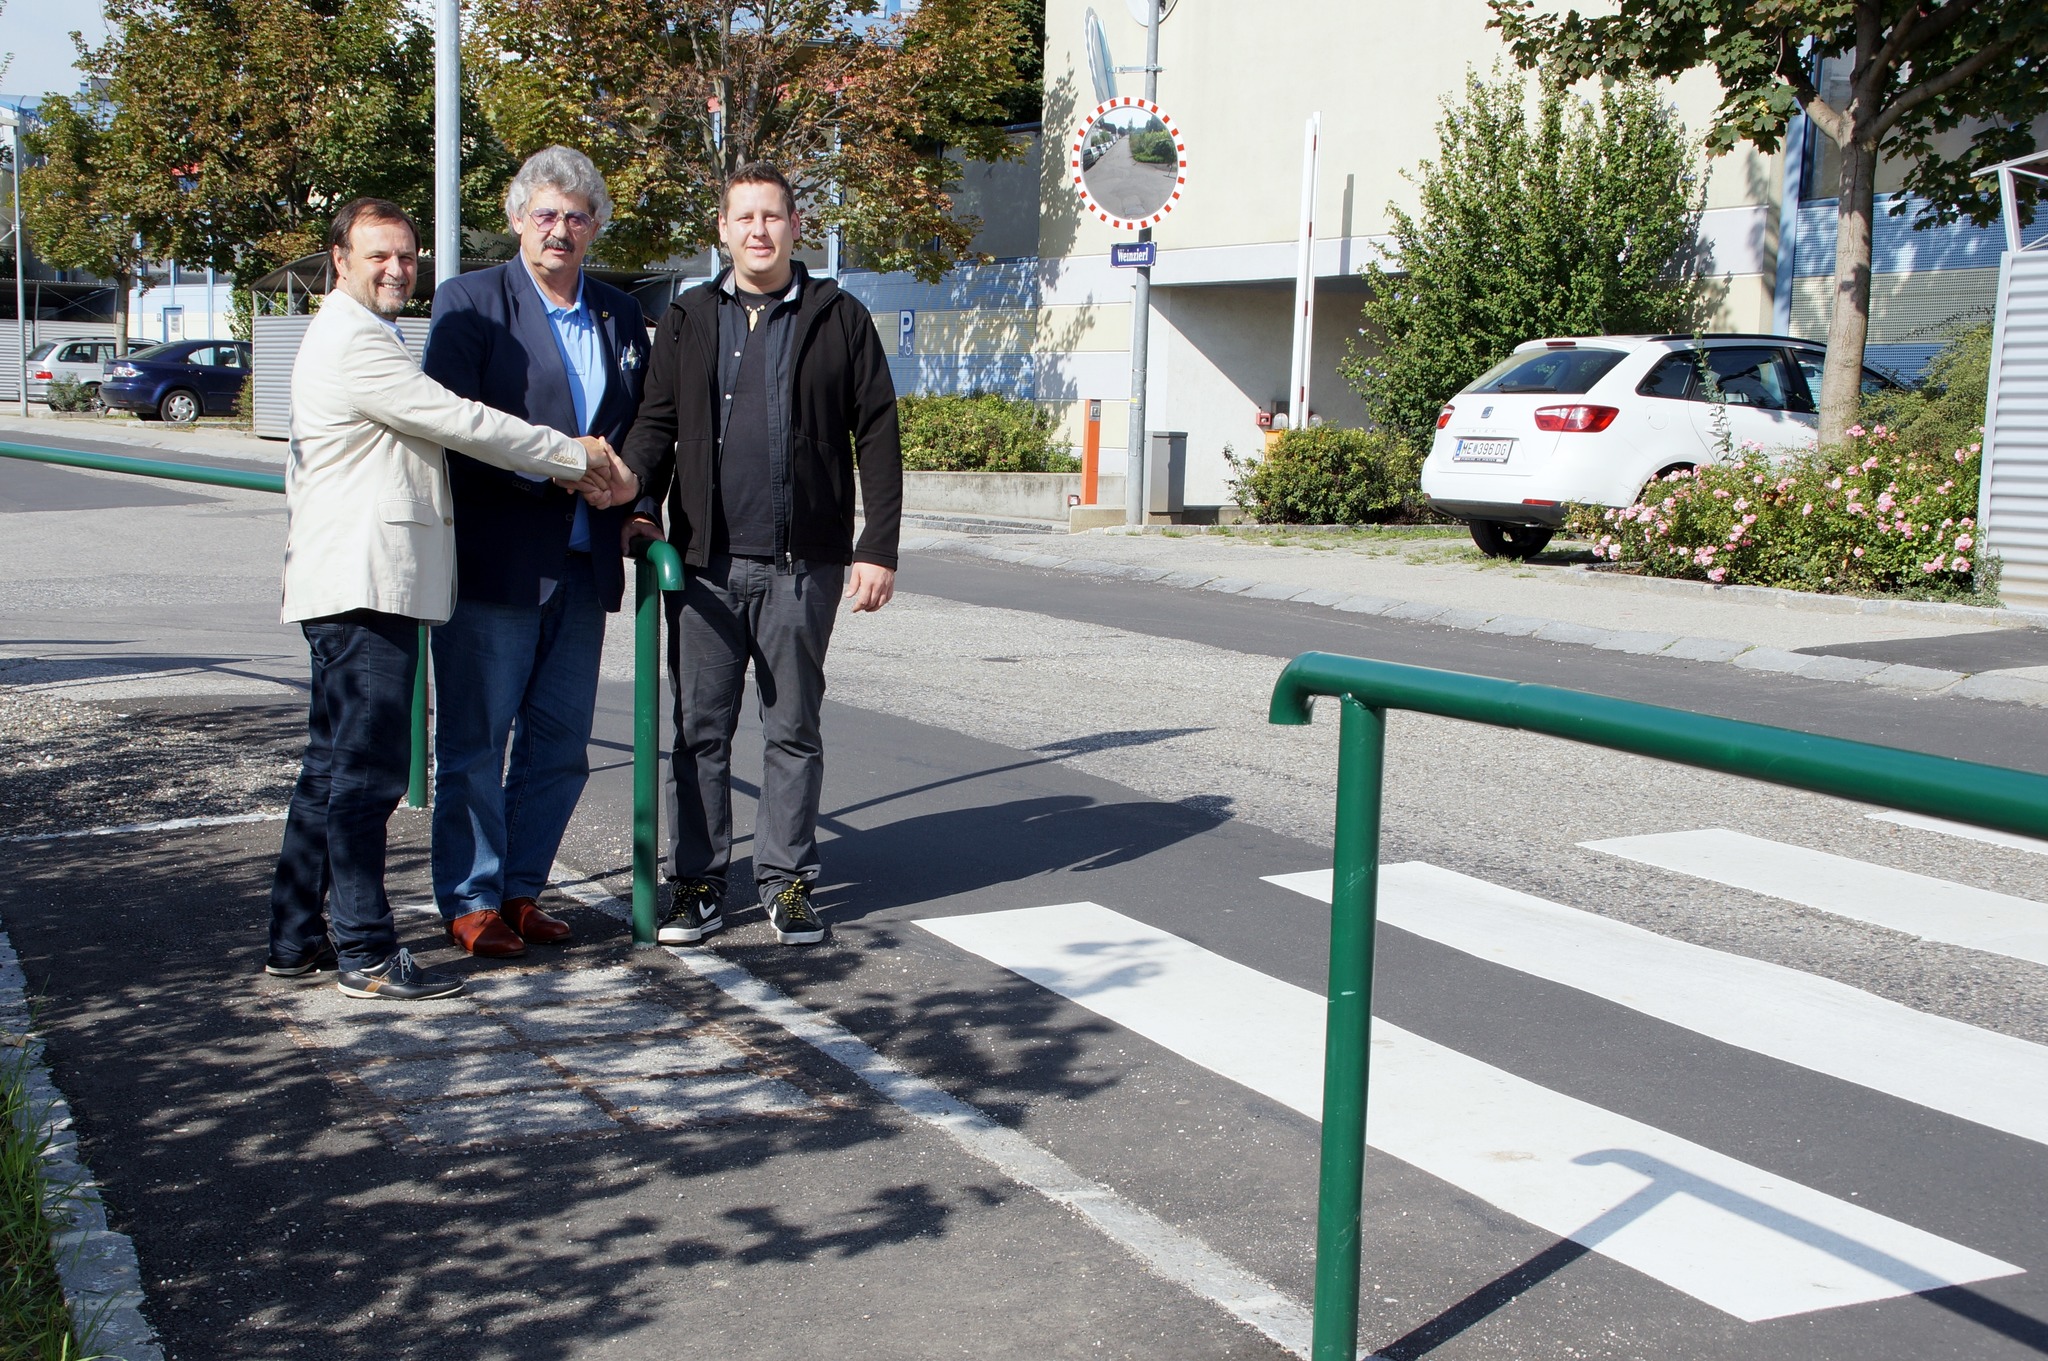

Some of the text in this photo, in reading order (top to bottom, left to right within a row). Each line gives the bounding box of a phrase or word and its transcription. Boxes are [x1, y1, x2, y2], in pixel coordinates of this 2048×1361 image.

[1117, 247, 1149, 262] Weinzierl
[900, 310, 913, 346] P
[1477, 442, 1495, 455] 396
